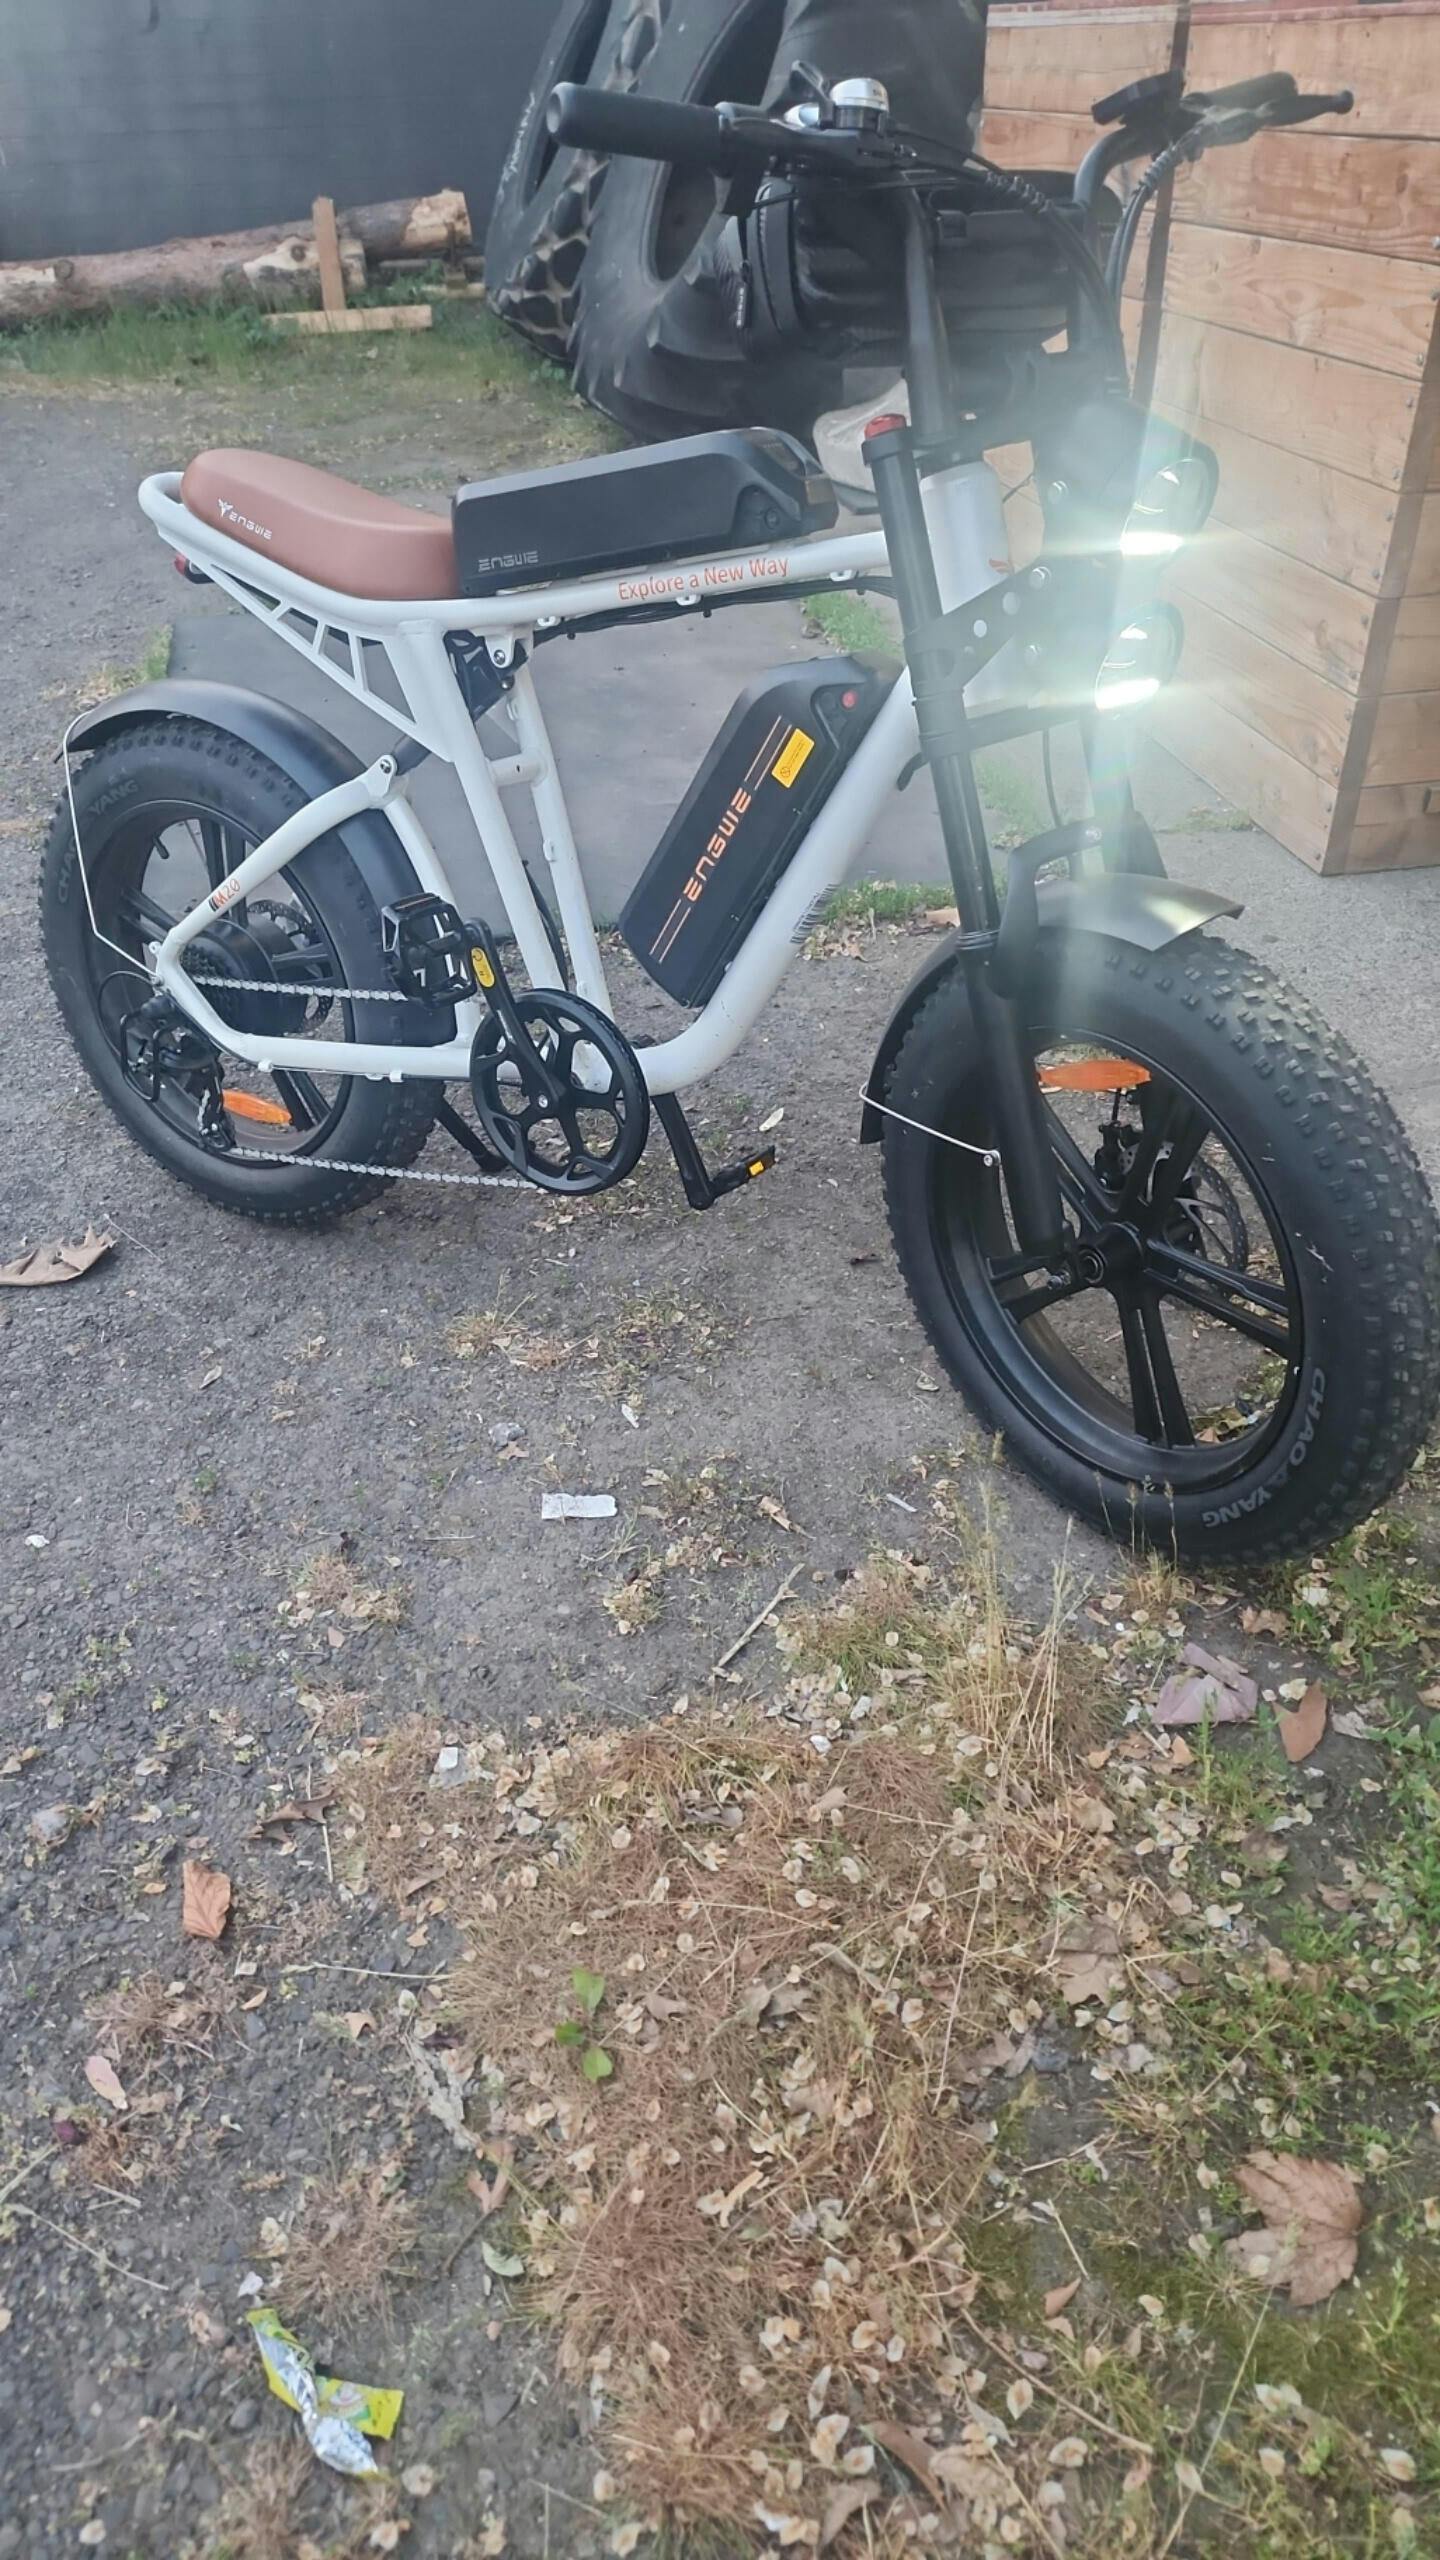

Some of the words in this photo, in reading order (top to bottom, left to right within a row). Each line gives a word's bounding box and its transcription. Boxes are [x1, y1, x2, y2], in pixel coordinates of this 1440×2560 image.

[478, 550, 539, 573] ENGWE
[618, 576, 685, 601] Explore
[688, 574, 700, 588] a
[704, 564, 744, 586] New
[748, 557, 789, 577] Way
[683, 787, 752, 902] ENGWE
[212, 878, 241, 908] M20
